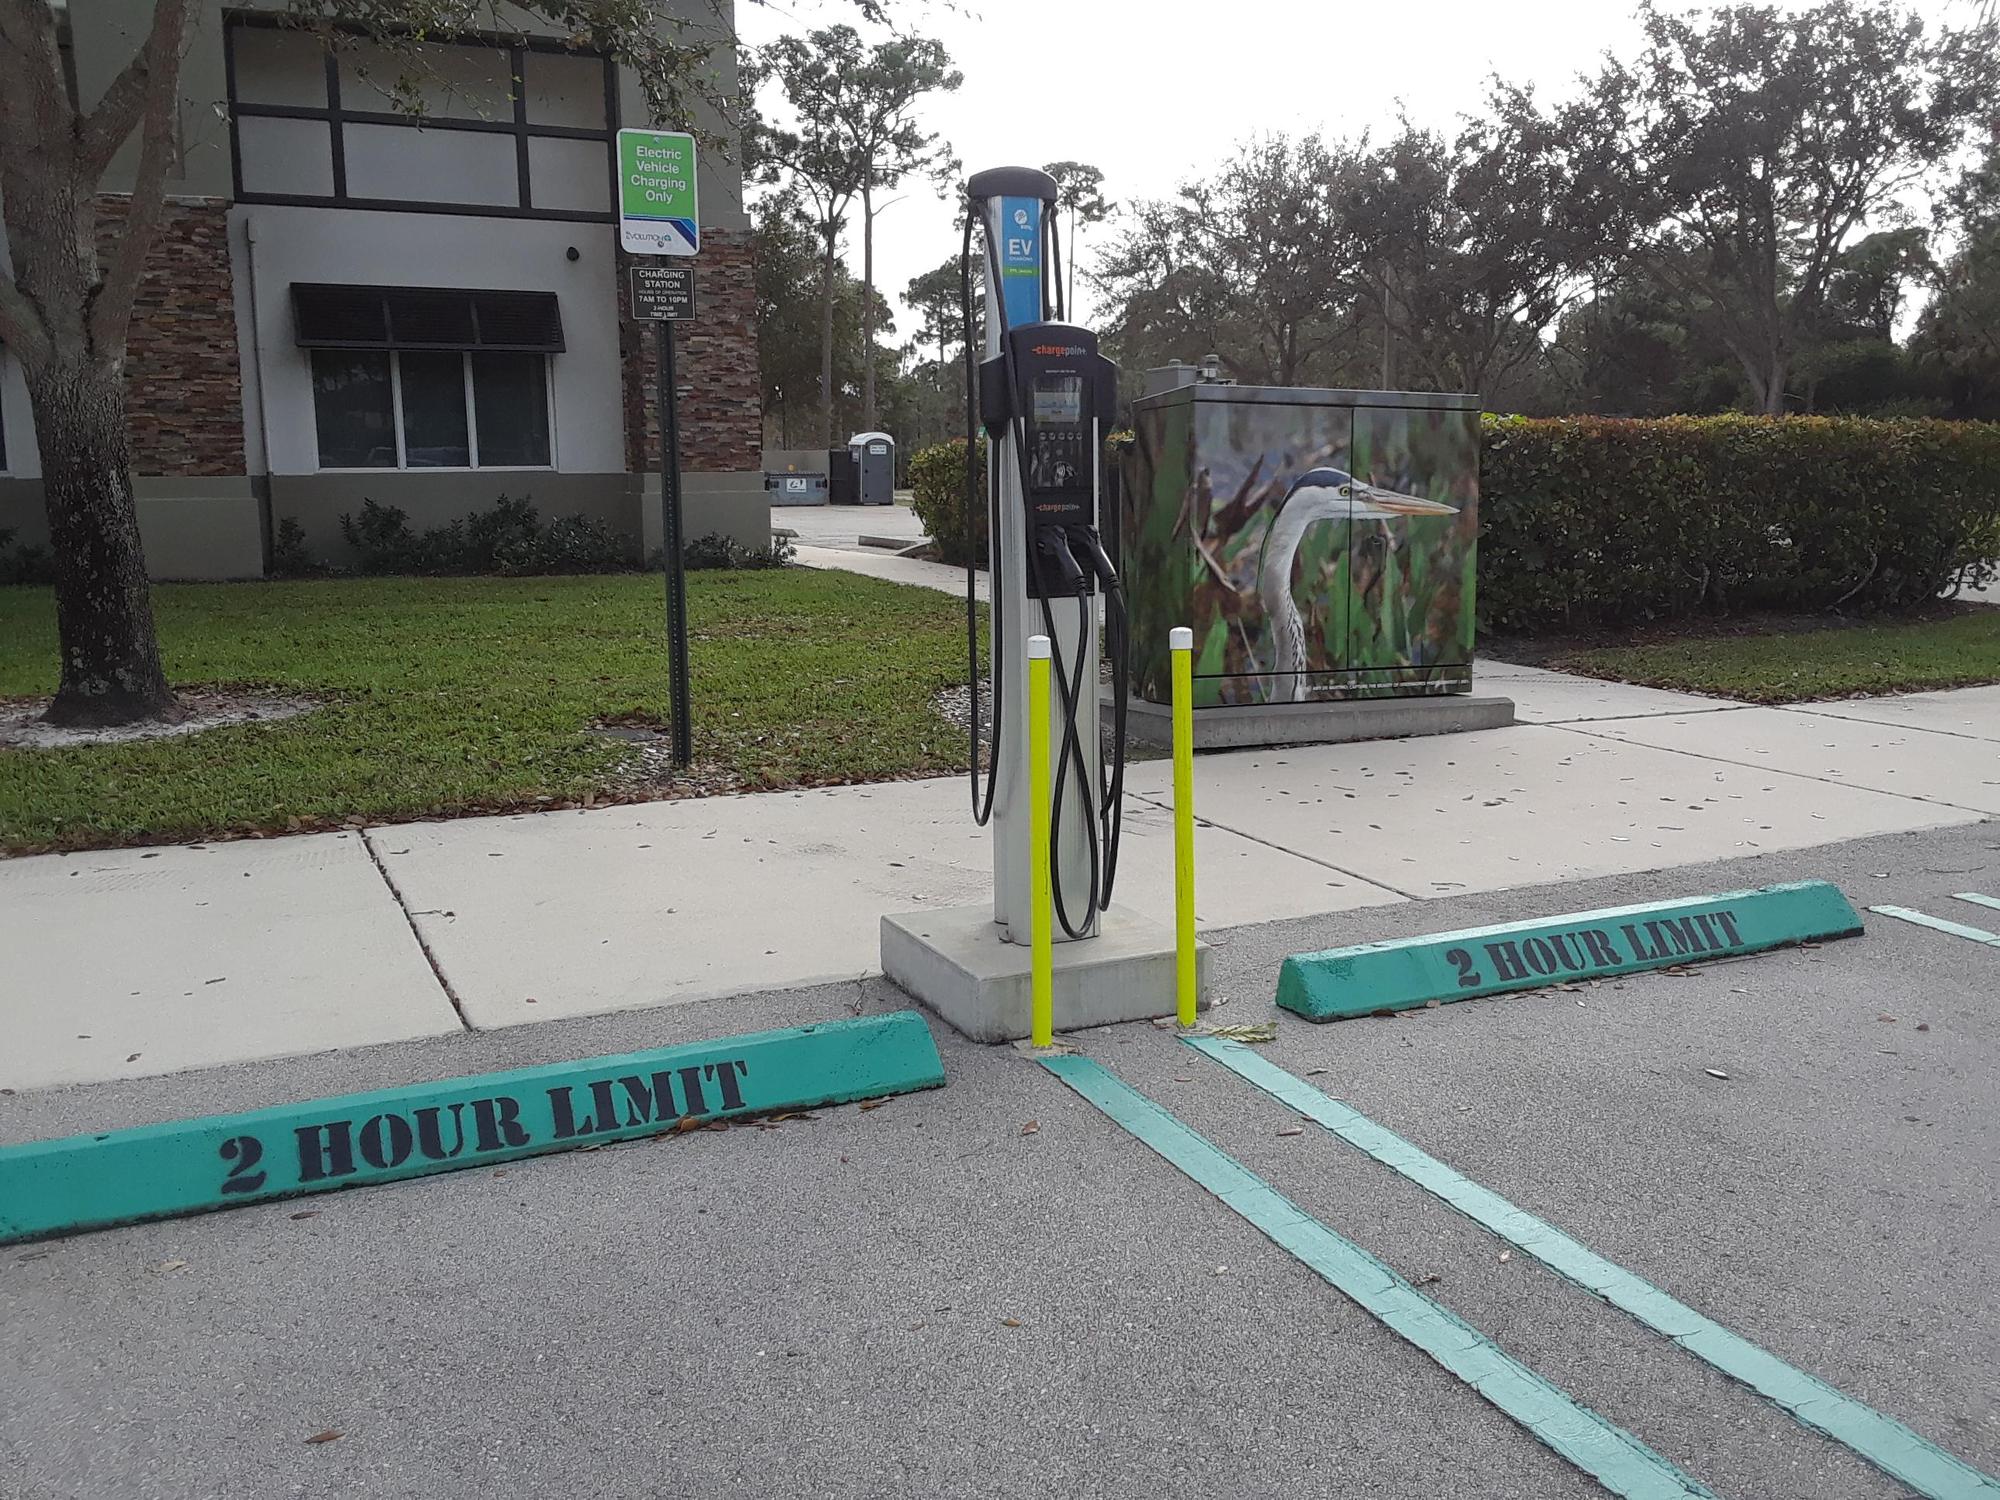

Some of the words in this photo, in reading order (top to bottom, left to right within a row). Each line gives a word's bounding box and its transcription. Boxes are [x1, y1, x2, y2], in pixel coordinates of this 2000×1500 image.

[636, 146, 682, 160] Electric
[636, 160, 680, 174] Vehicle
[631, 174, 687, 191] Charging
[646, 190, 673, 205] Only
[1009, 238, 1033, 256] EV
[639, 270, 685, 279] CHARGING
[644, 280, 681, 289] STATION
[639, 295, 655, 303] 7AM
[669, 296, 688, 304] 10PM
[1446, 948, 1481, 989] 2
[1484, 929, 1623, 982] HOUR
[1620, 910, 1745, 962] LIMIT
[219, 1135, 266, 1195] 2
[295, 1096, 531, 1183] HOUR
[546, 1060, 749, 1139] LIMIT
